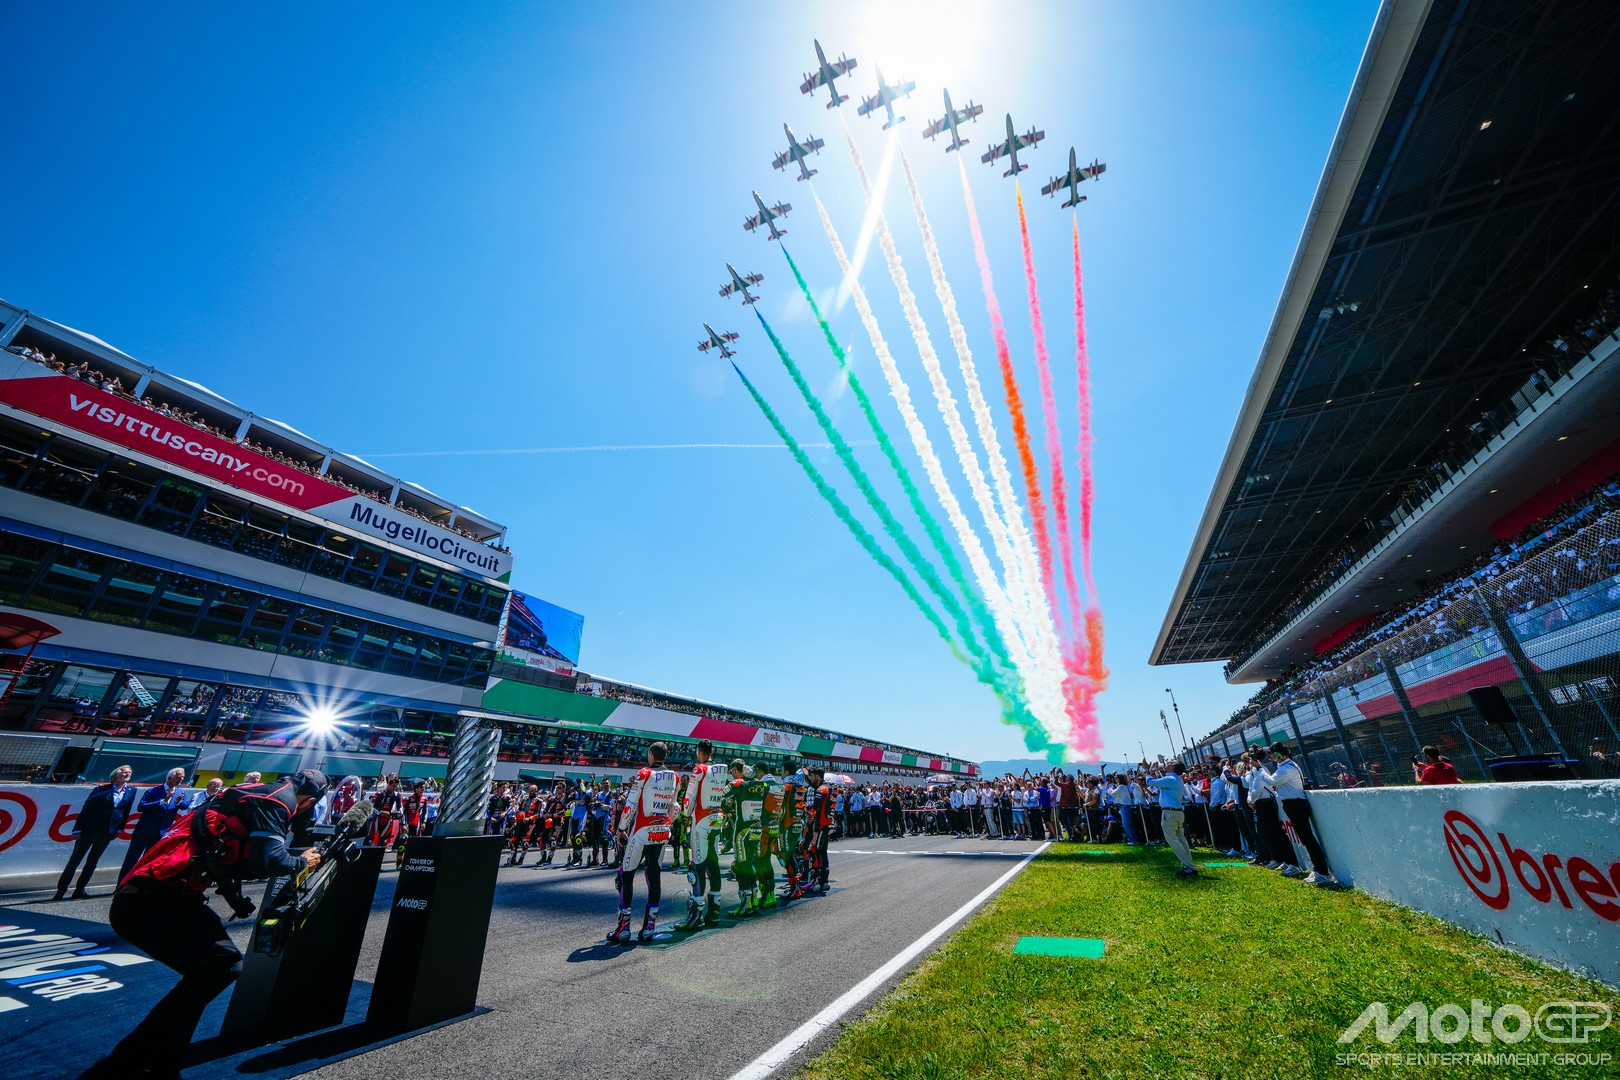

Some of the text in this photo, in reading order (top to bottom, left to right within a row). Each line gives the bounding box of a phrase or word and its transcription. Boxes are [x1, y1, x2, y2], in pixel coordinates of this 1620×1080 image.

[350, 502, 500, 574] MugelloCircuit
[1496, 832, 1620, 922] bre
[396, 897, 428, 910] MotoGP
[18, 974, 124, 1001] FOR
